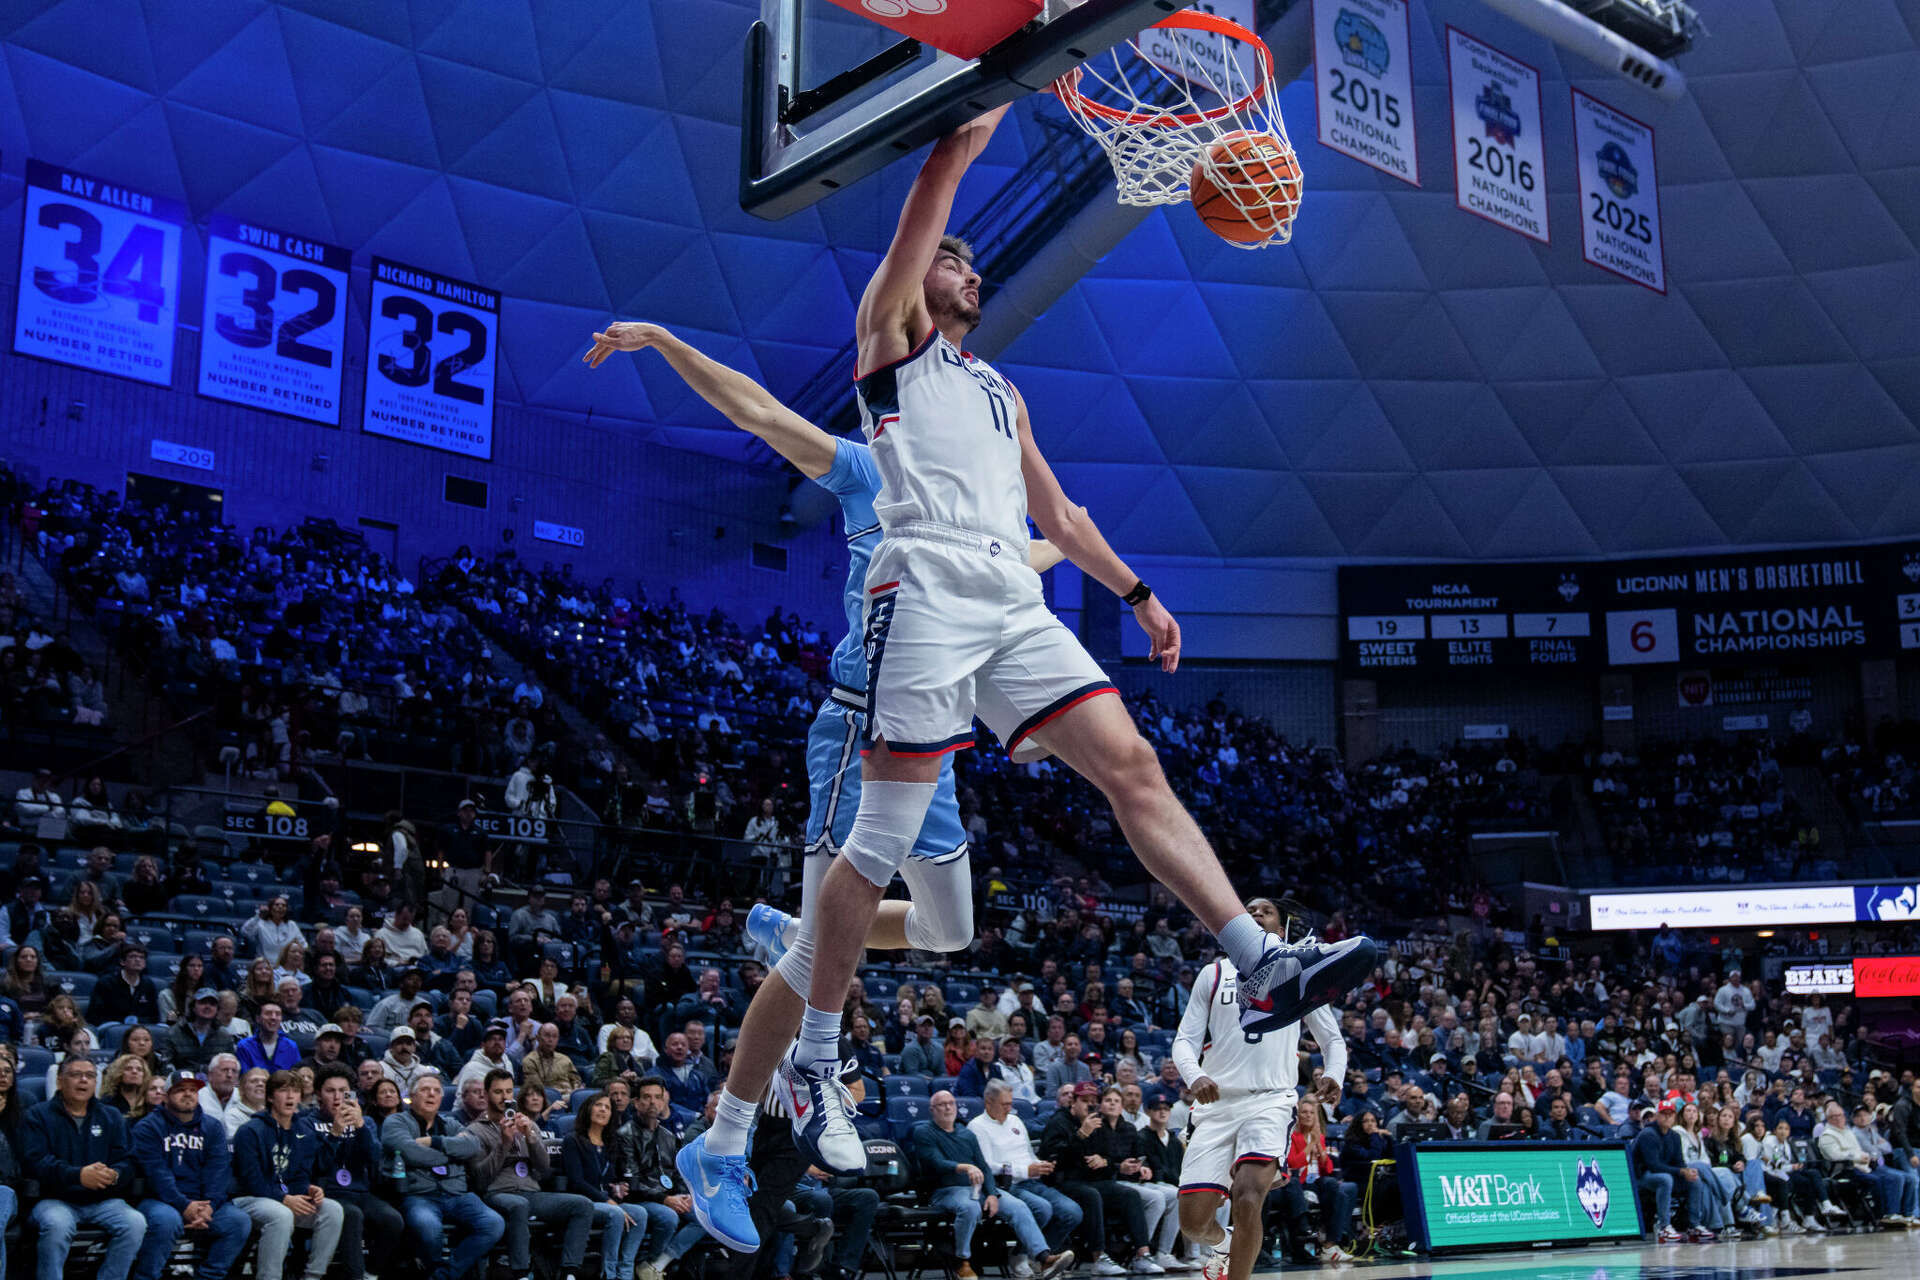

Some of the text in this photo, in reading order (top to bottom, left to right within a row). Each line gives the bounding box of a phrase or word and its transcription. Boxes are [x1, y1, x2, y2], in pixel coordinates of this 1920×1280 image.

[1330, 68, 1401, 128] 2015
[1335, 110, 1401, 151] NATIONAL
[1330, 128, 1408, 174] CHAMPIONS
[1468, 137, 1534, 192] 2016
[61, 173, 153, 214] RAY ALLEN
[1472, 175, 1533, 212] NATIONAL
[1468, 193, 1539, 234] CHAMPIONS
[1590, 192, 1652, 245] 2025
[239, 224, 324, 262] SWIN CASH
[1596, 230, 1651, 264] NATIONAL
[33, 203, 165, 325] 34
[1593, 247, 1656, 284] CHAMPIONS
[378, 263, 495, 309] RICHARD HAMILTON
[215, 252, 337, 369] 32
[24, 328, 91, 351] NUMBER
[98, 345, 163, 369] RETIRED
[377, 295, 487, 406] 32
[207, 372, 267, 393] NUMBER
[273, 386, 332, 409] RETIRED
[371, 409, 425, 429] NUMBER
[430, 421, 485, 444] RETIRED
[979, 383, 1013, 440] 11
[178, 448, 211, 466] 209
[558, 528, 582, 543] 210
[1432, 584, 1471, 595] NCAA
[1617, 560, 1864, 594] UCONN MEN'S BASKETBALL
[1406, 598, 1499, 609] TOURNAMENT
[1376, 620, 1397, 636] 19
[1459, 619, 1480, 635] 13
[1545, 617, 1557, 632] 7
[1630, 621, 1656, 653] 6
[1694, 605, 1864, 636] NATIONAL
[1359, 642, 1416, 655] SWEET
[1448, 640, 1493, 653] ELITE
[1530, 639, 1576, 651] FINAL
[1530, 652, 1577, 664] FOURS
[1694, 630, 1867, 654] CHAMPIONSHIPS
[1359, 656, 1417, 667] SIXTEENS
[1449, 654, 1493, 665] EIGHTS
[226, 816, 308, 836] SEC 108
[474, 817, 546, 837] SEC 109
[1022, 893, 1047, 910] 110
[1785, 968, 1854, 986] BEAR'S
[1438, 1173, 1545, 1207] M&T Bank
[1445, 1210, 1560, 1224] Official Bank of the UConn Huskies
